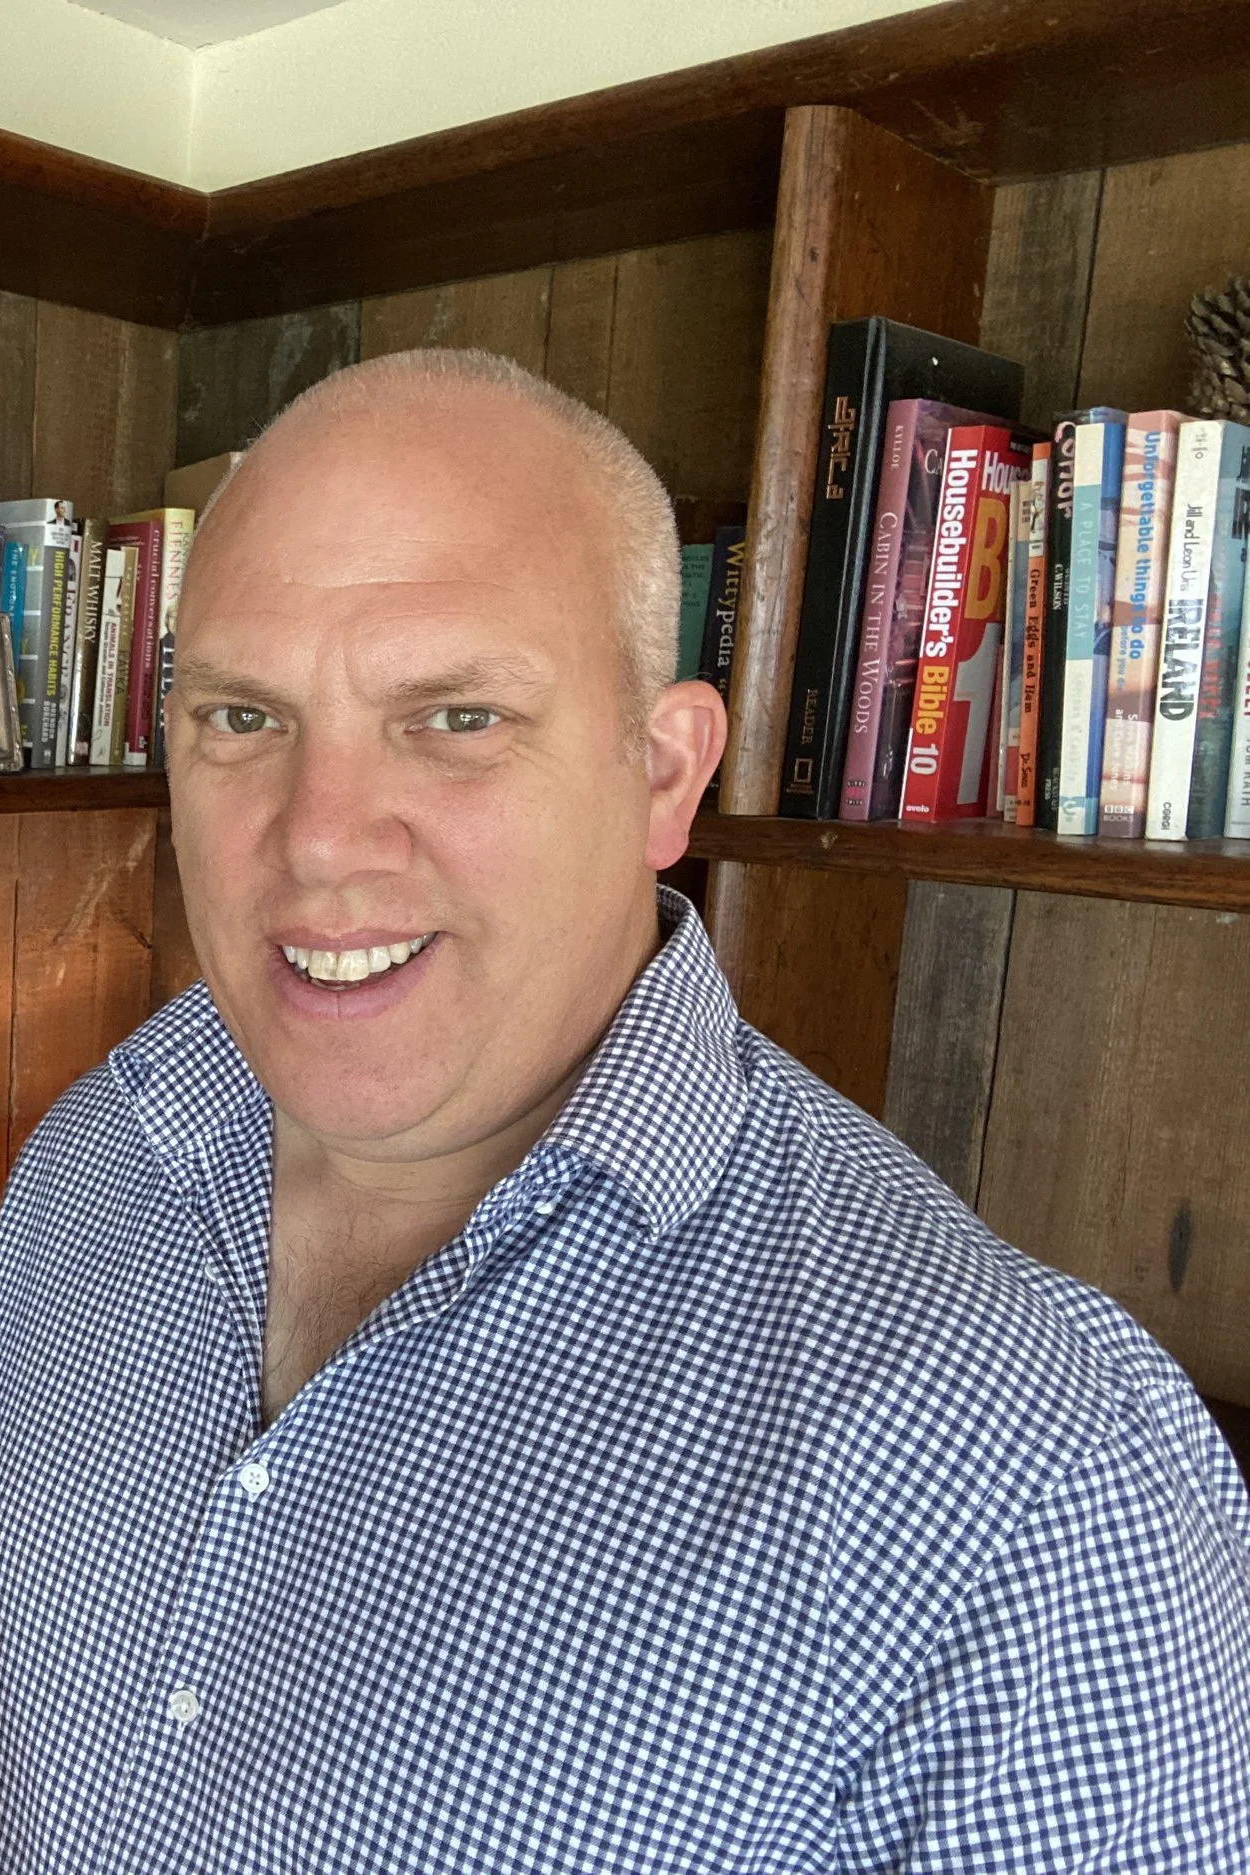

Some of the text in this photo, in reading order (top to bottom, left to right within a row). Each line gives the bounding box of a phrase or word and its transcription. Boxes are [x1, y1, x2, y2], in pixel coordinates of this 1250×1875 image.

[1136, 430, 1162, 553] Unforgettable
[1186, 504, 1205, 518] Jill
[151, 529, 160, 577] crucial
[1183, 519, 1199, 539] and
[54, 550, 65, 577] HIGH
[165, 520, 184, 601] FIENNES
[1073, 501, 1093, 639] A PLACE TO STAY
[1181, 541, 1200, 570] Leon
[83, 539, 103, 644] MALT WHISKY
[1130, 558, 1152, 612] things
[49, 578, 63, 657] PERFORMANCE
[144, 579, 157, 669] conversations
[854, 511, 898, 734] CABIN IN THE WOODS
[910, 448, 979, 776] Housebuilder's Bible 10
[108, 622, 118, 659] ANIMALS
[1024, 568, 1041, 713] Green Eggs and Ham
[1129, 639, 1146, 660] do
[46, 659, 59, 697] HABITS
[115, 649, 129, 695] KAFKA
[103, 672, 113, 727] TRANSLATION
[801, 688, 819, 745] READER
[905, 804, 931, 814] ovolo
[1103, 814, 1134, 822] BOOKS
[1104, 805, 1135, 815] BBC
[1161, 801, 1173, 831] CORGI
